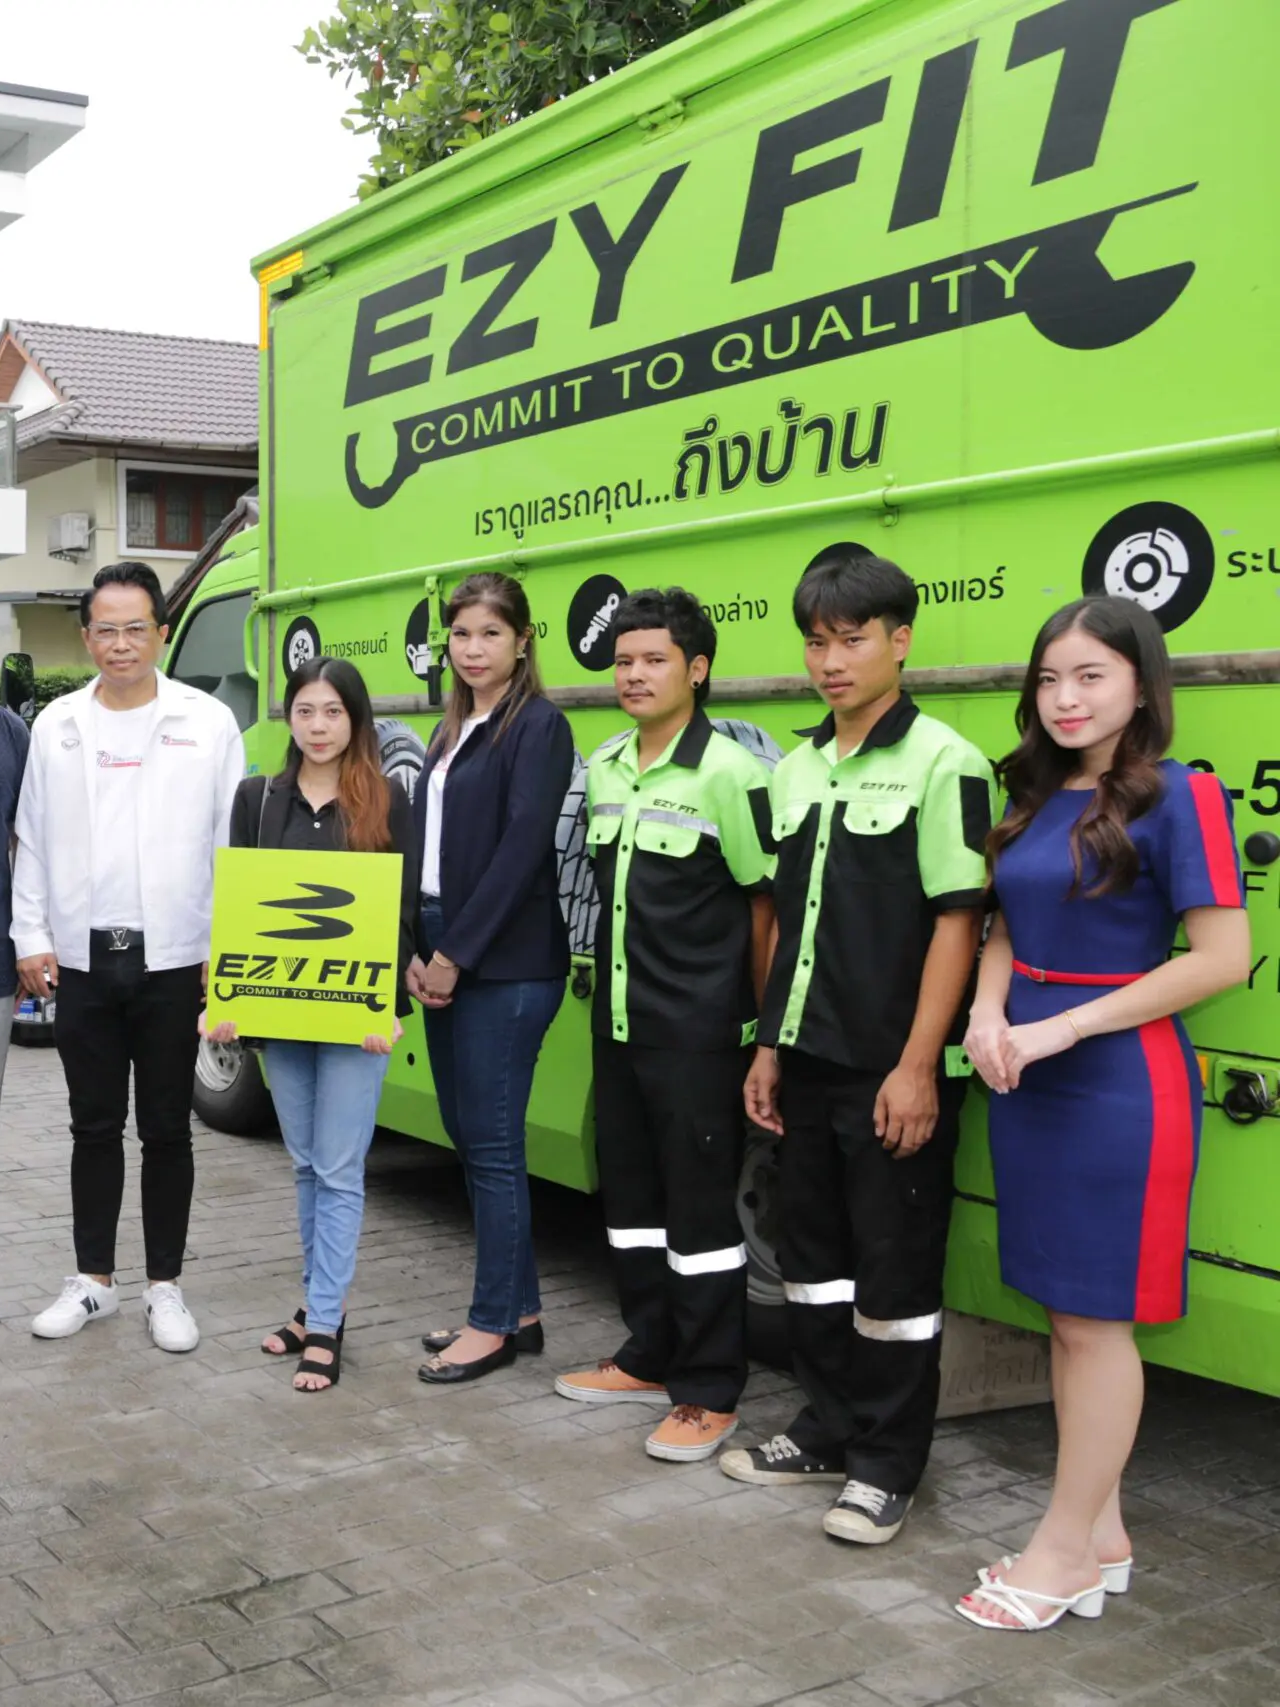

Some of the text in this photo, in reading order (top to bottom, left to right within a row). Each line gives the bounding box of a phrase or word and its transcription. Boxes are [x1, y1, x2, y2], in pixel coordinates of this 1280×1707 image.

[343, 0, 1180, 409] EZY FIT
[411, 246, 1039, 454] COMMIT TO QUALITY
[860, 782, 908, 792] EZY FIT
[653, 799, 699, 815] EZY FIT
[215, 953, 392, 987] EZY FIT
[236, 985, 368, 1002] COMMIT TO QUALITY
